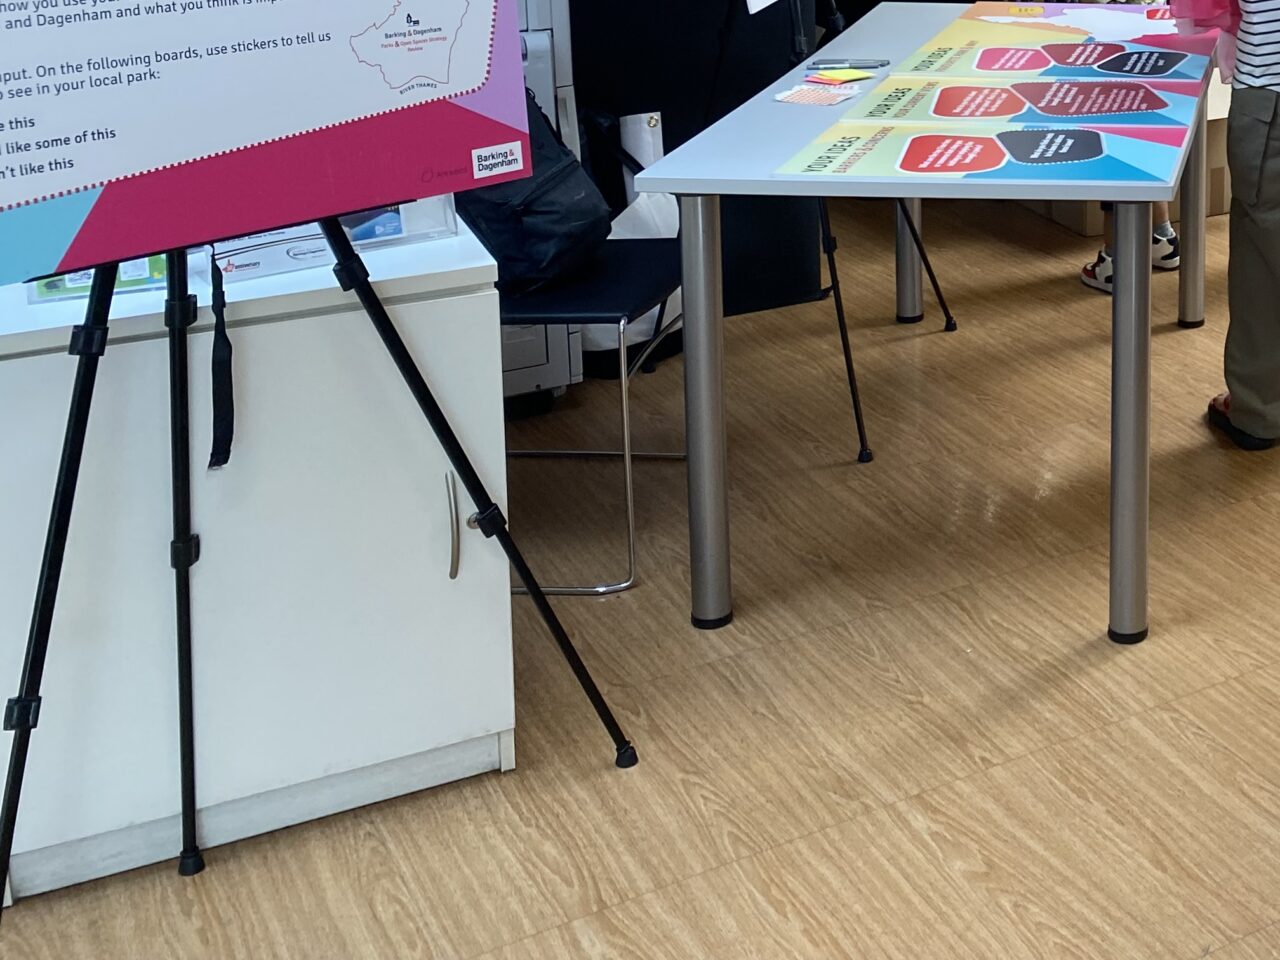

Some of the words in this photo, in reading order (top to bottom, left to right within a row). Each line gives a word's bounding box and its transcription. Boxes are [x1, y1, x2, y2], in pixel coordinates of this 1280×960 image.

[5, 15, 32, 30] and
[36, 9, 112, 28] Dagenham
[116, 4, 141, 18] and
[144, 1, 178, 16] what
[180, 1, 203, 15] you
[385, 31, 407, 39] Barking
[407, 29, 412, 37] &
[413, 27, 442, 36] Dagenham
[35, 65, 56, 78] On
[60, 62, 83, 75] the
[87, 54, 151, 72] following
[154, 47, 203, 63] boards,
[206, 45, 228, 57] use
[231, 38, 278, 53] stickers
[281, 36, 293, 47] to
[296, 32, 315, 45] tell
[318, 32, 331, 42] us
[8, 86, 33, 99] see
[36, 83, 50, 95] in
[54, 80, 86, 96] your
[89, 72, 123, 88] local
[127, 68, 161, 86] park:
[400, 84, 415, 95] RIVER
[864, 102, 893, 118] YOUR
[884, 88, 912, 104] IDEAS
[8, 117, 35, 130] this
[6, 140, 31, 155] like
[35, 136, 71, 150] some
[74, 130, 88, 144] of
[91, 128, 116, 141] this
[477, 151, 508, 163] Barking
[508, 149, 515, 157] &
[478, 158, 518, 172] Dagenham
[801, 155, 836, 173] YOUR
[824, 136, 861, 159] IDEAS
[19, 162, 45, 176] like
[48, 158, 74, 171] this
